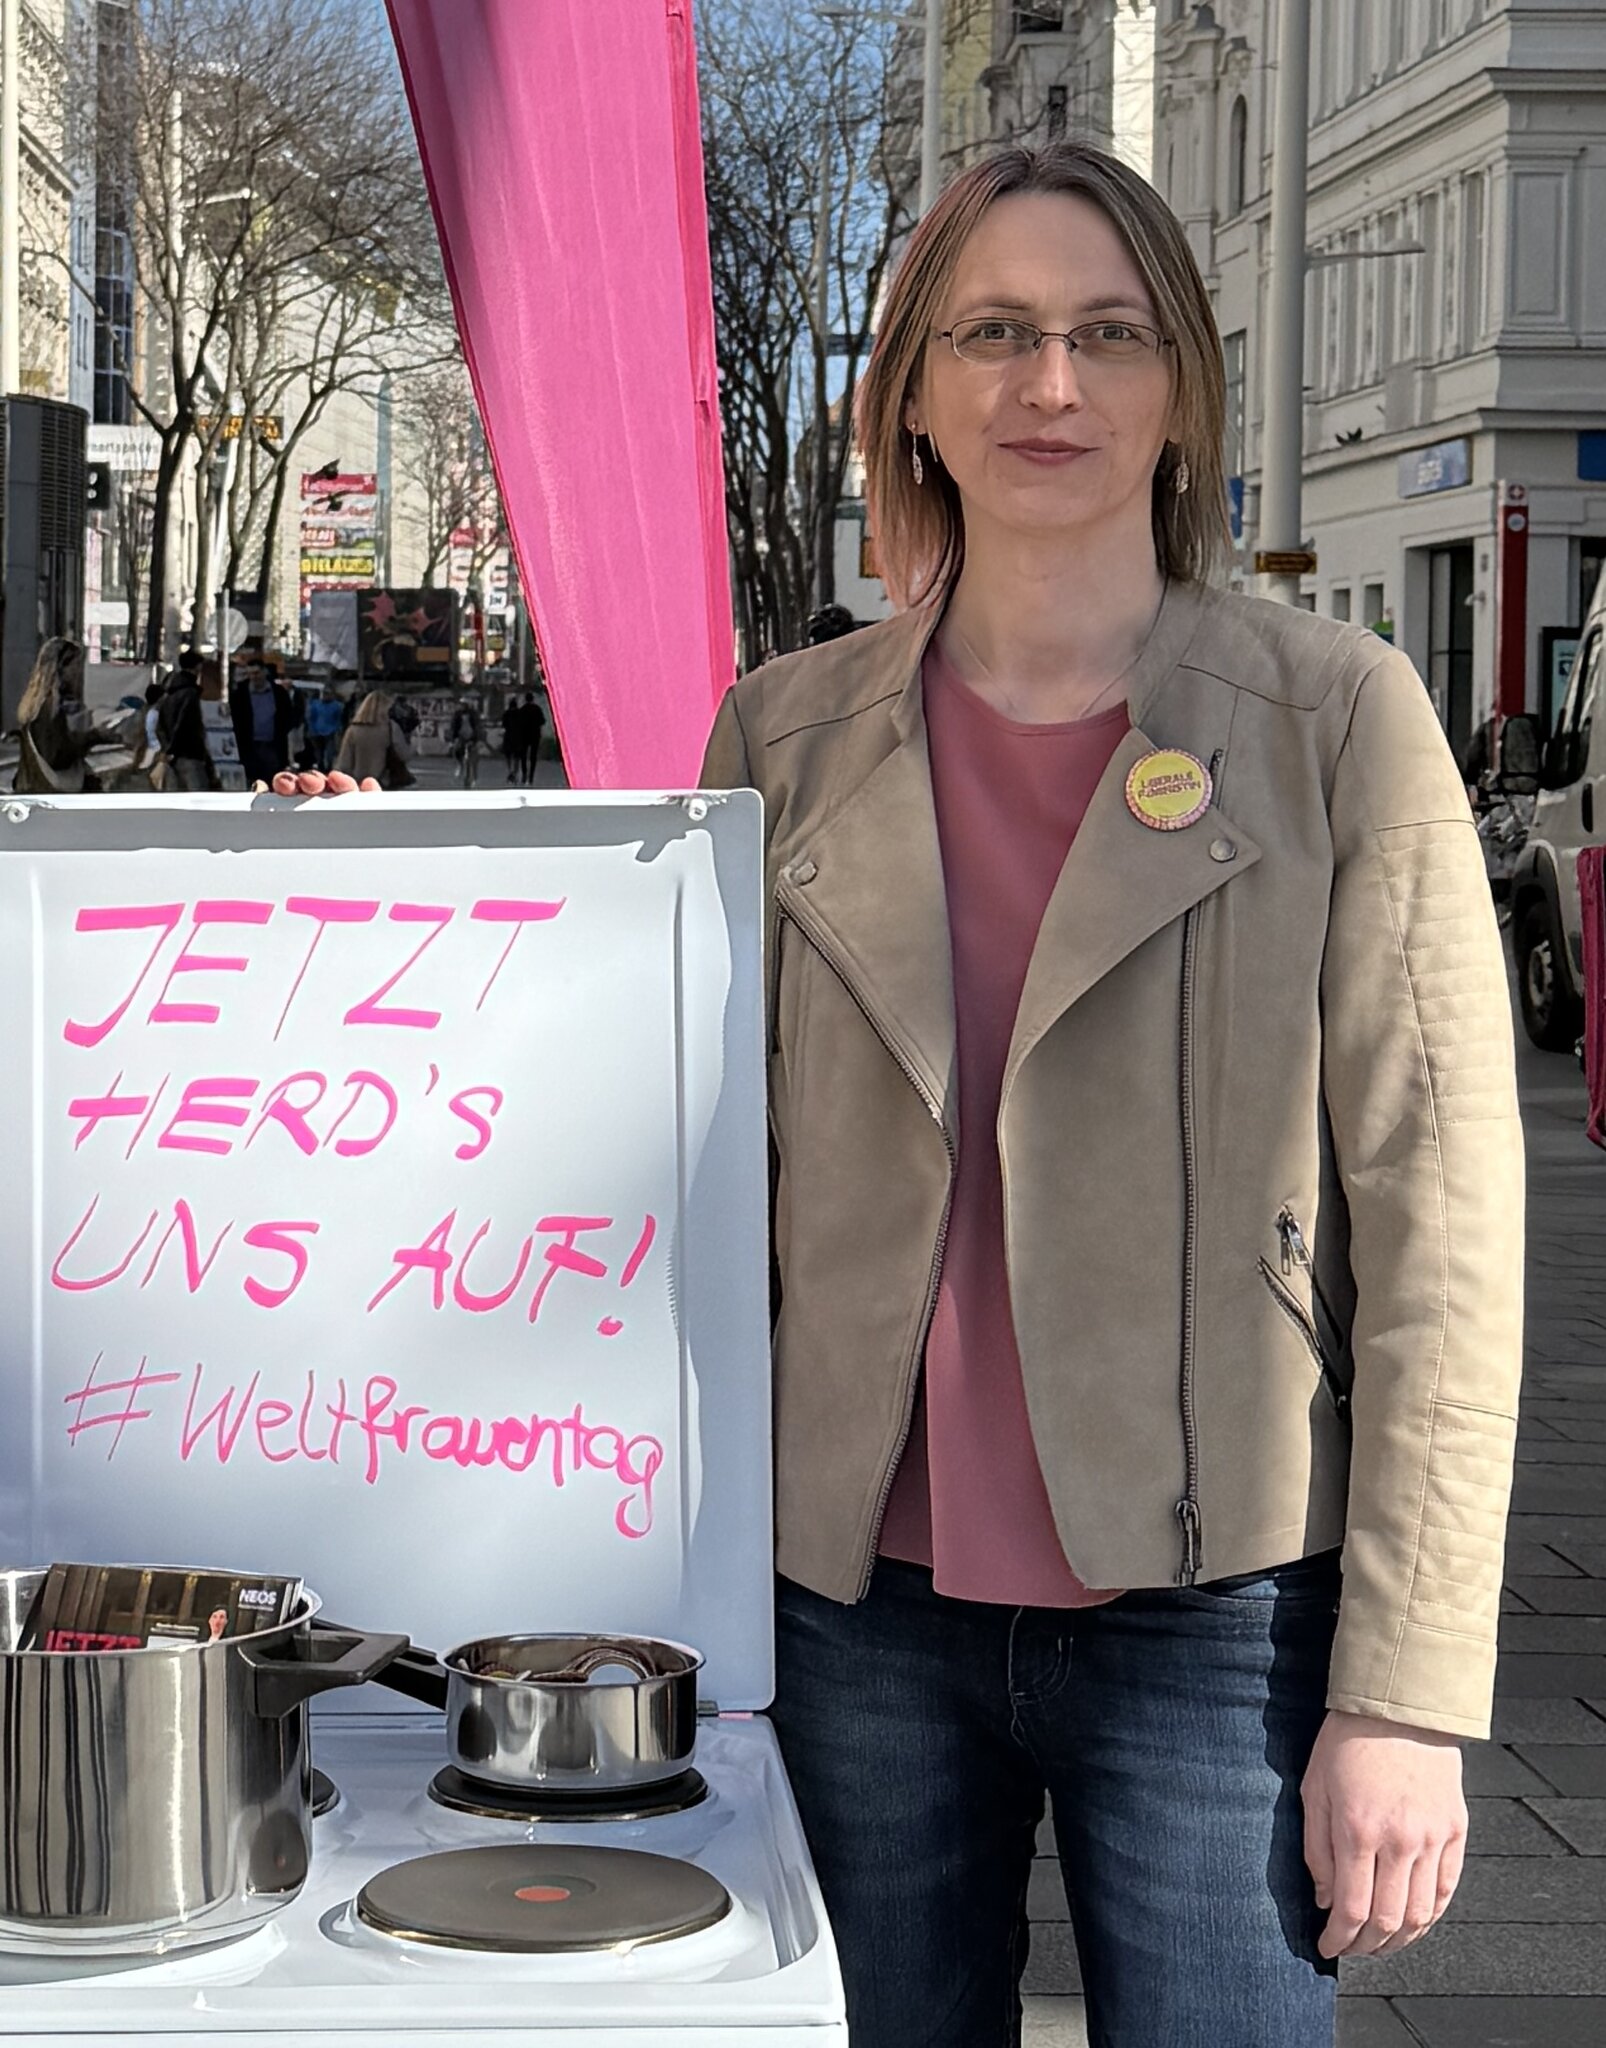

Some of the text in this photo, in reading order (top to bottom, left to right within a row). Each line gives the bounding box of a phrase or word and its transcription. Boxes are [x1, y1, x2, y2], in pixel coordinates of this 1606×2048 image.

[64, 896, 568, 1049] JETZT
[51, 1191, 657, 1337] UNS AUF!
[64, 1351, 664, 1540] #Weltfrauentag
[238, 1588, 278, 1605] NEOS
